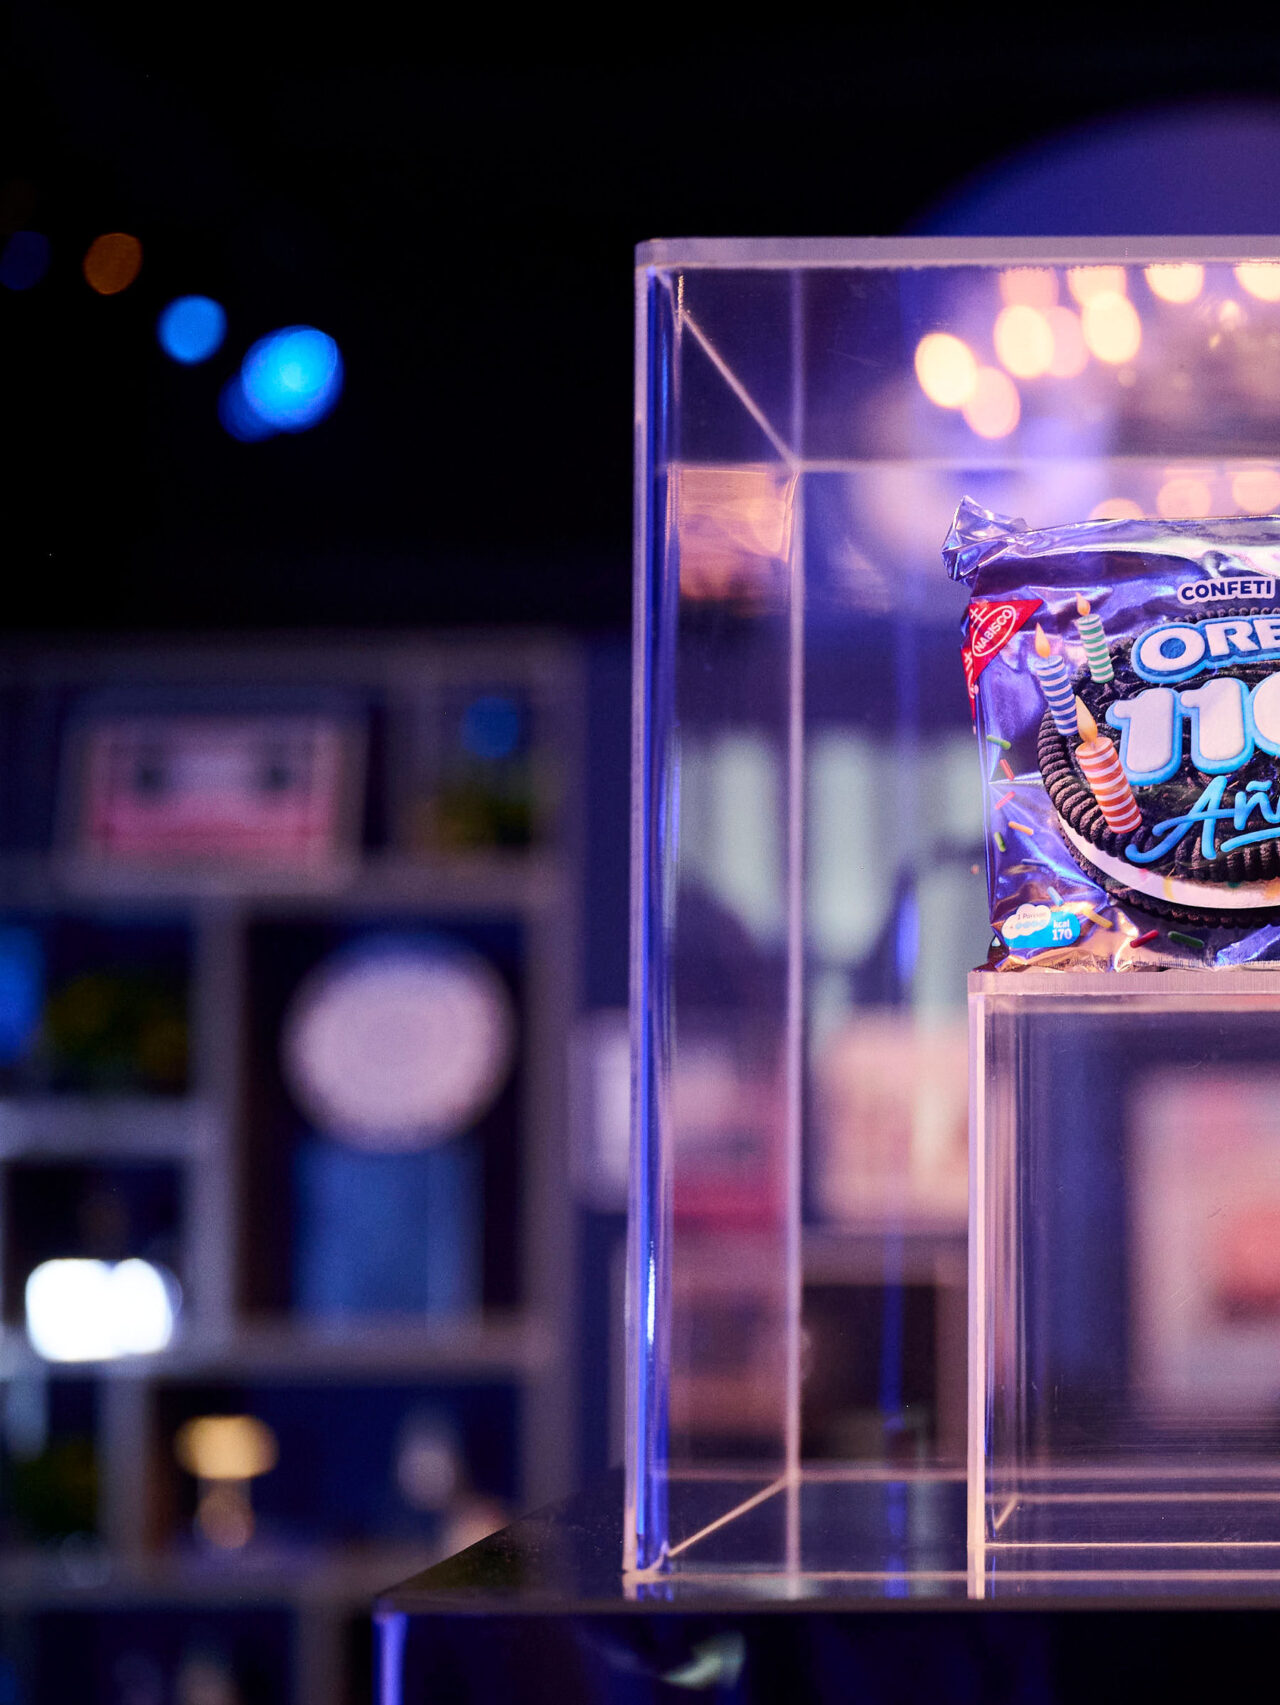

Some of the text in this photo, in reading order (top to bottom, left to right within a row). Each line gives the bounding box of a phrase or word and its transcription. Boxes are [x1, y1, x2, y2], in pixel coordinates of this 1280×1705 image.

[1181, 579, 1272, 600] CONFETI
[974, 608, 1013, 653] NABISCO
[1053, 919, 1070, 929] kcal
[1052, 929, 1073, 941] 170
